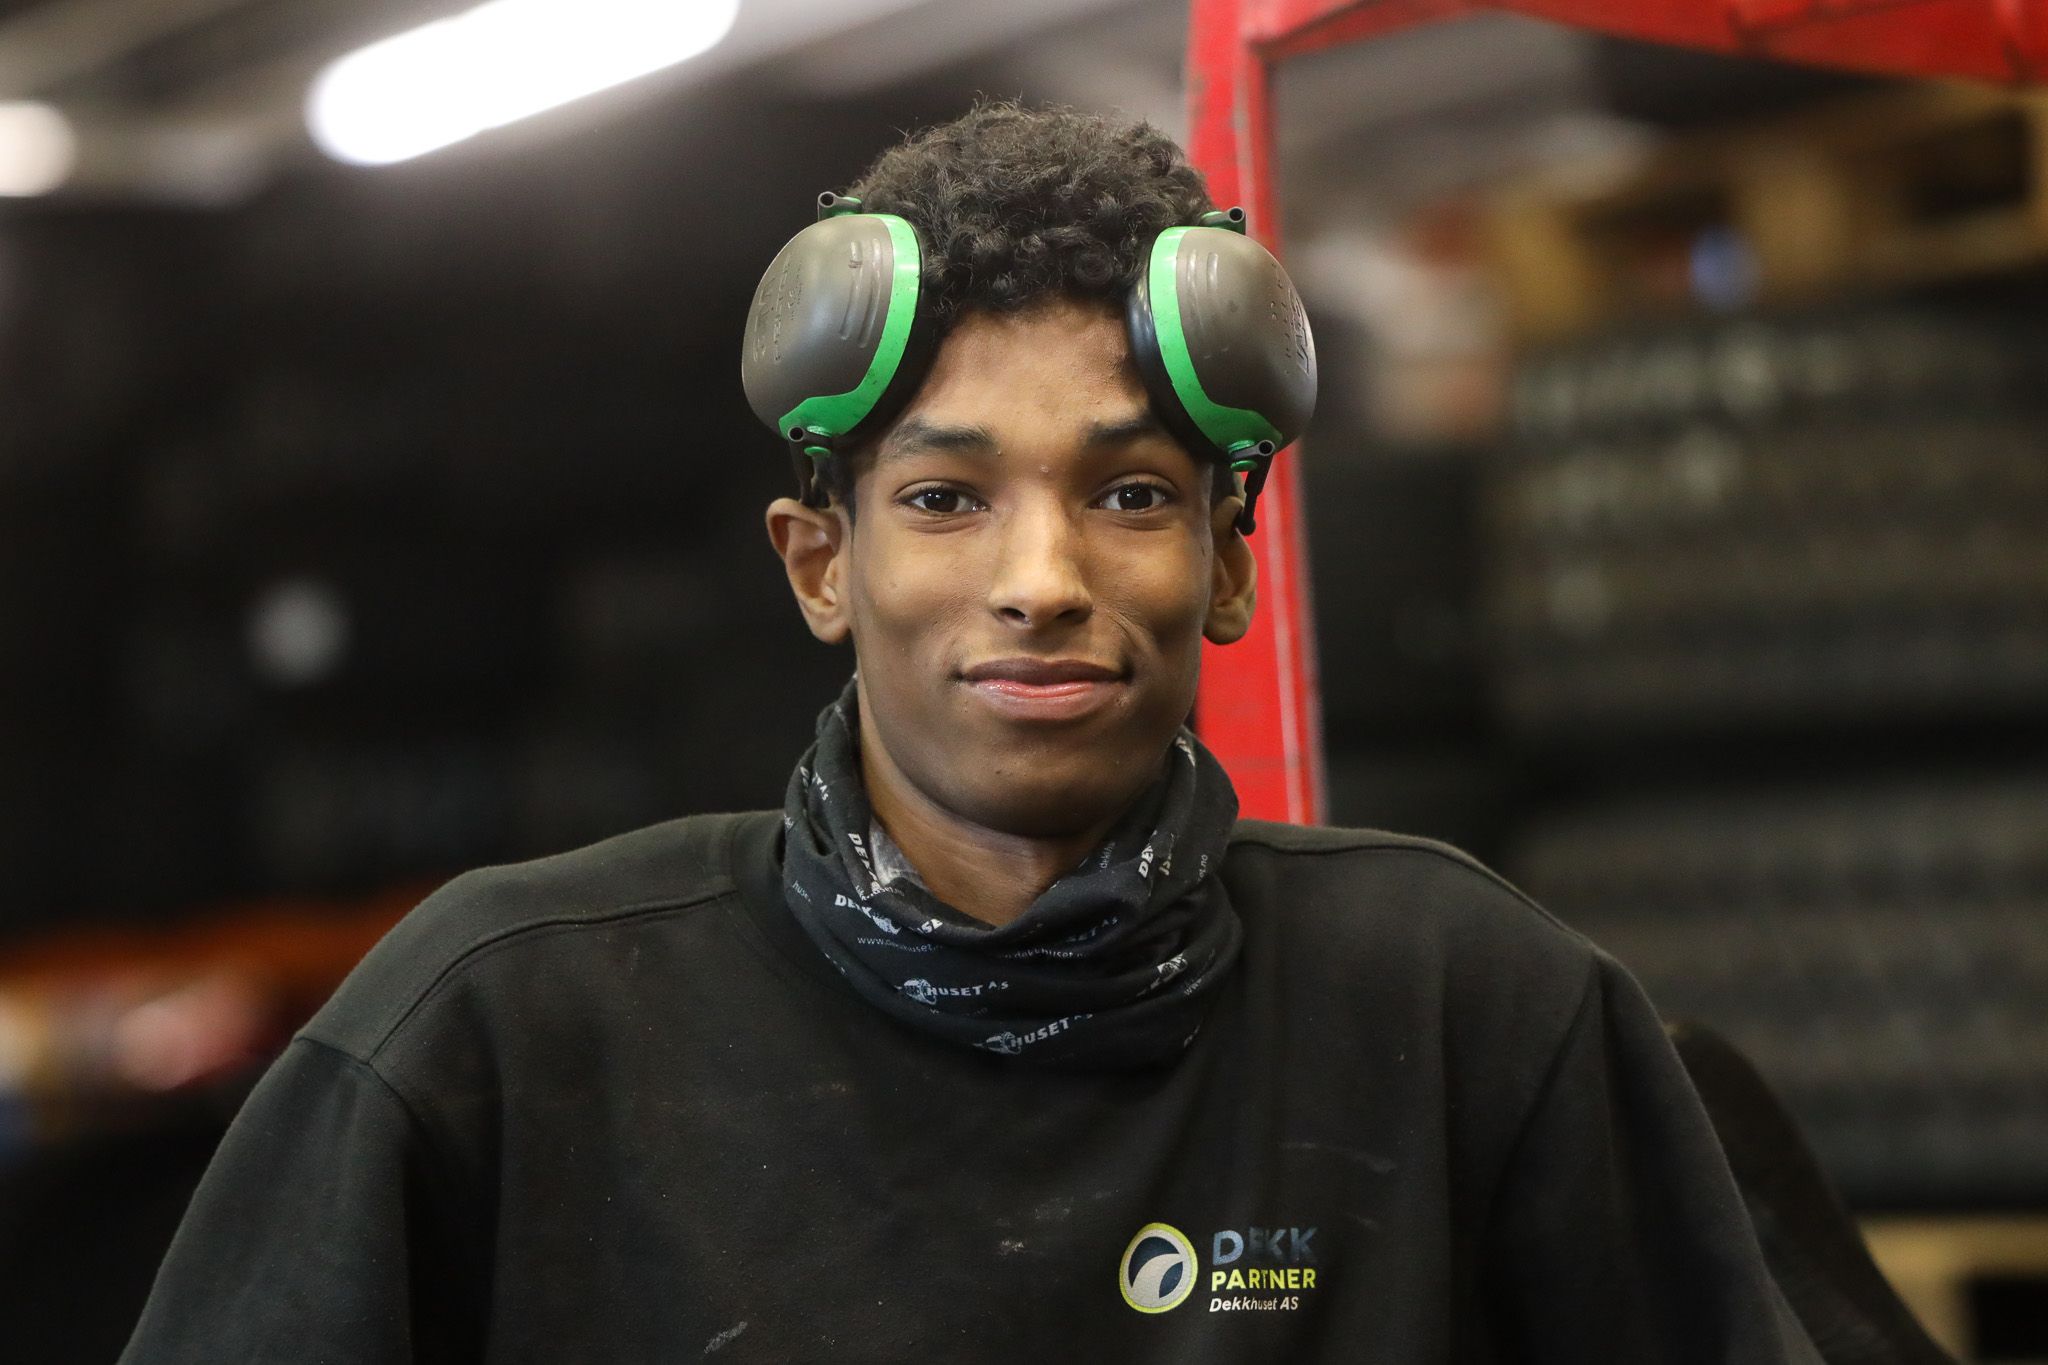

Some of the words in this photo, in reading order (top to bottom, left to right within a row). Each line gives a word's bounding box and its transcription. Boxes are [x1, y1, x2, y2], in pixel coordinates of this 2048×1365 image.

[926, 985, 983, 997] HUSET
[1010, 1017, 1070, 1048] HUSET
[1212, 1226, 1318, 1265] DEKK
[1211, 1268, 1316, 1292] PARTNER
[1209, 1297, 1277, 1312] Dekkhuset
[1280, 1296, 1299, 1310] AS
